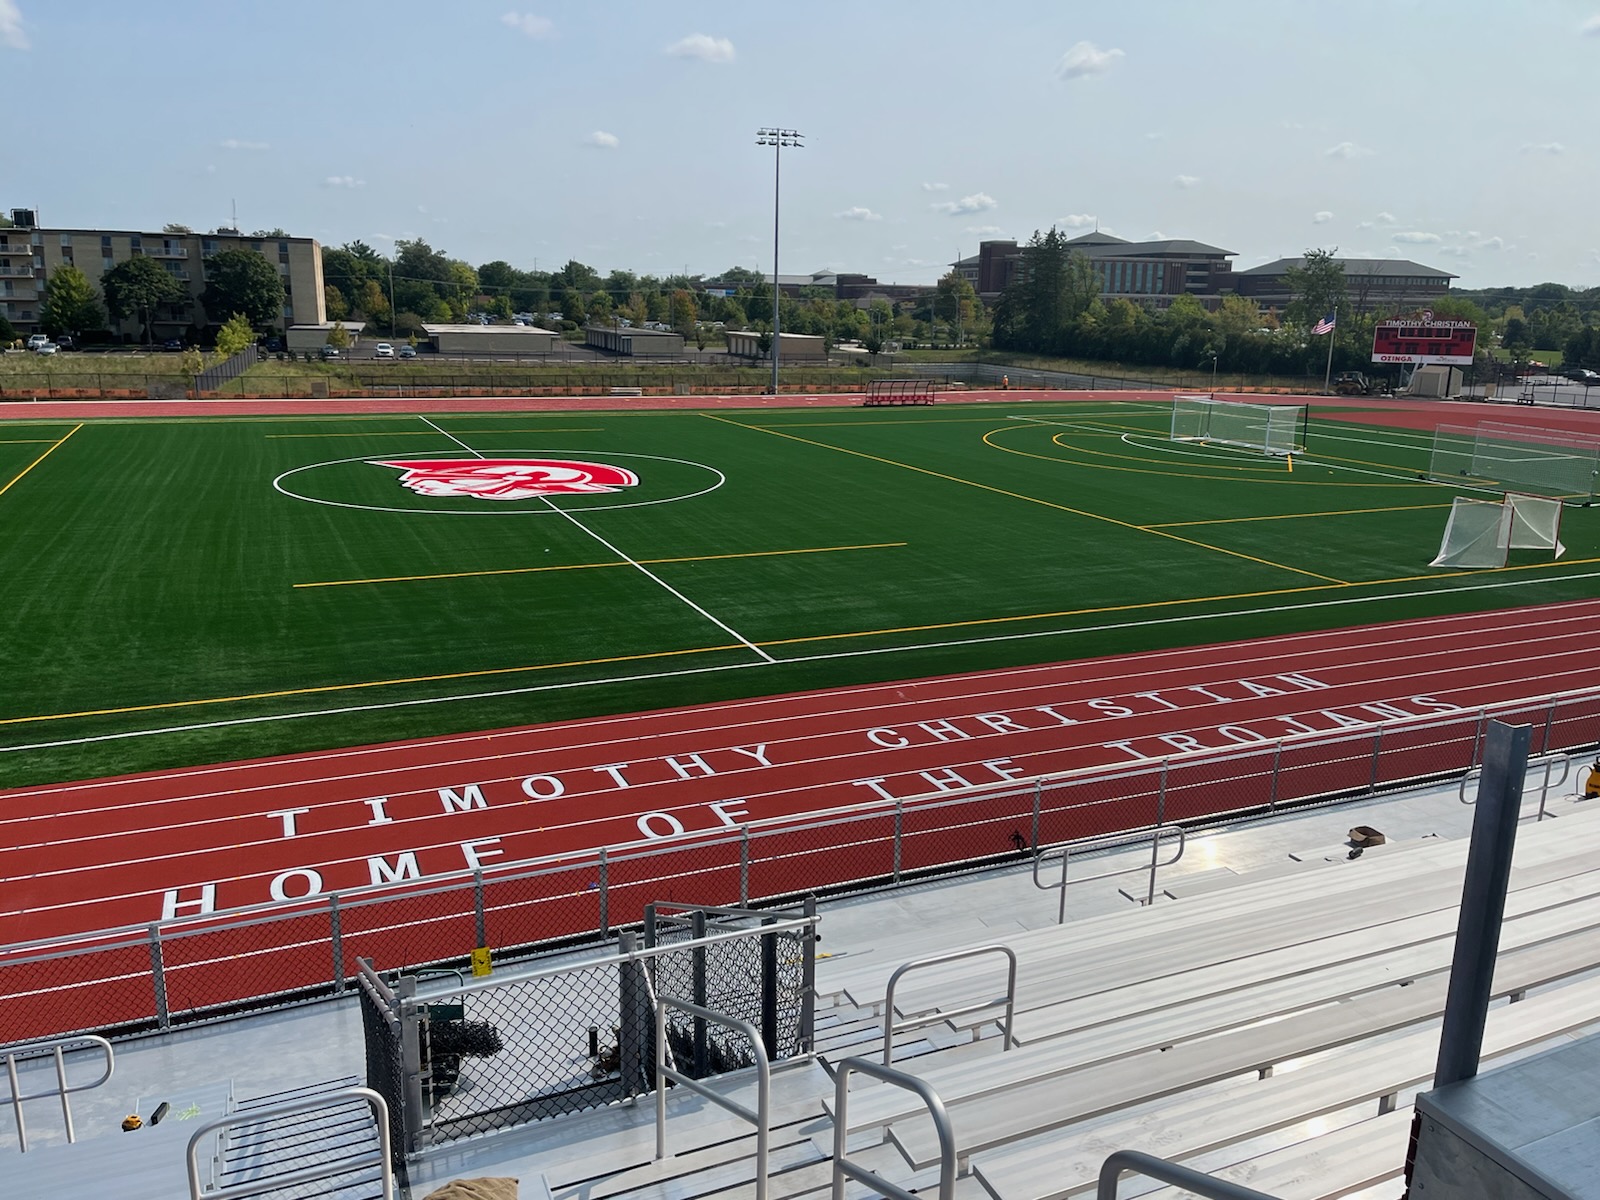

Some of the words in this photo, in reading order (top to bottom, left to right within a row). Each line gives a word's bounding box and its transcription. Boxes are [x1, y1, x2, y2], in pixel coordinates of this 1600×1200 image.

[1424, 320, 1471, 328] CHRISTIAN
[266, 743, 774, 838] TIMOTHY
[866, 672, 1331, 749] CHRISTIAN
[1104, 694, 1464, 760] TROJANS
